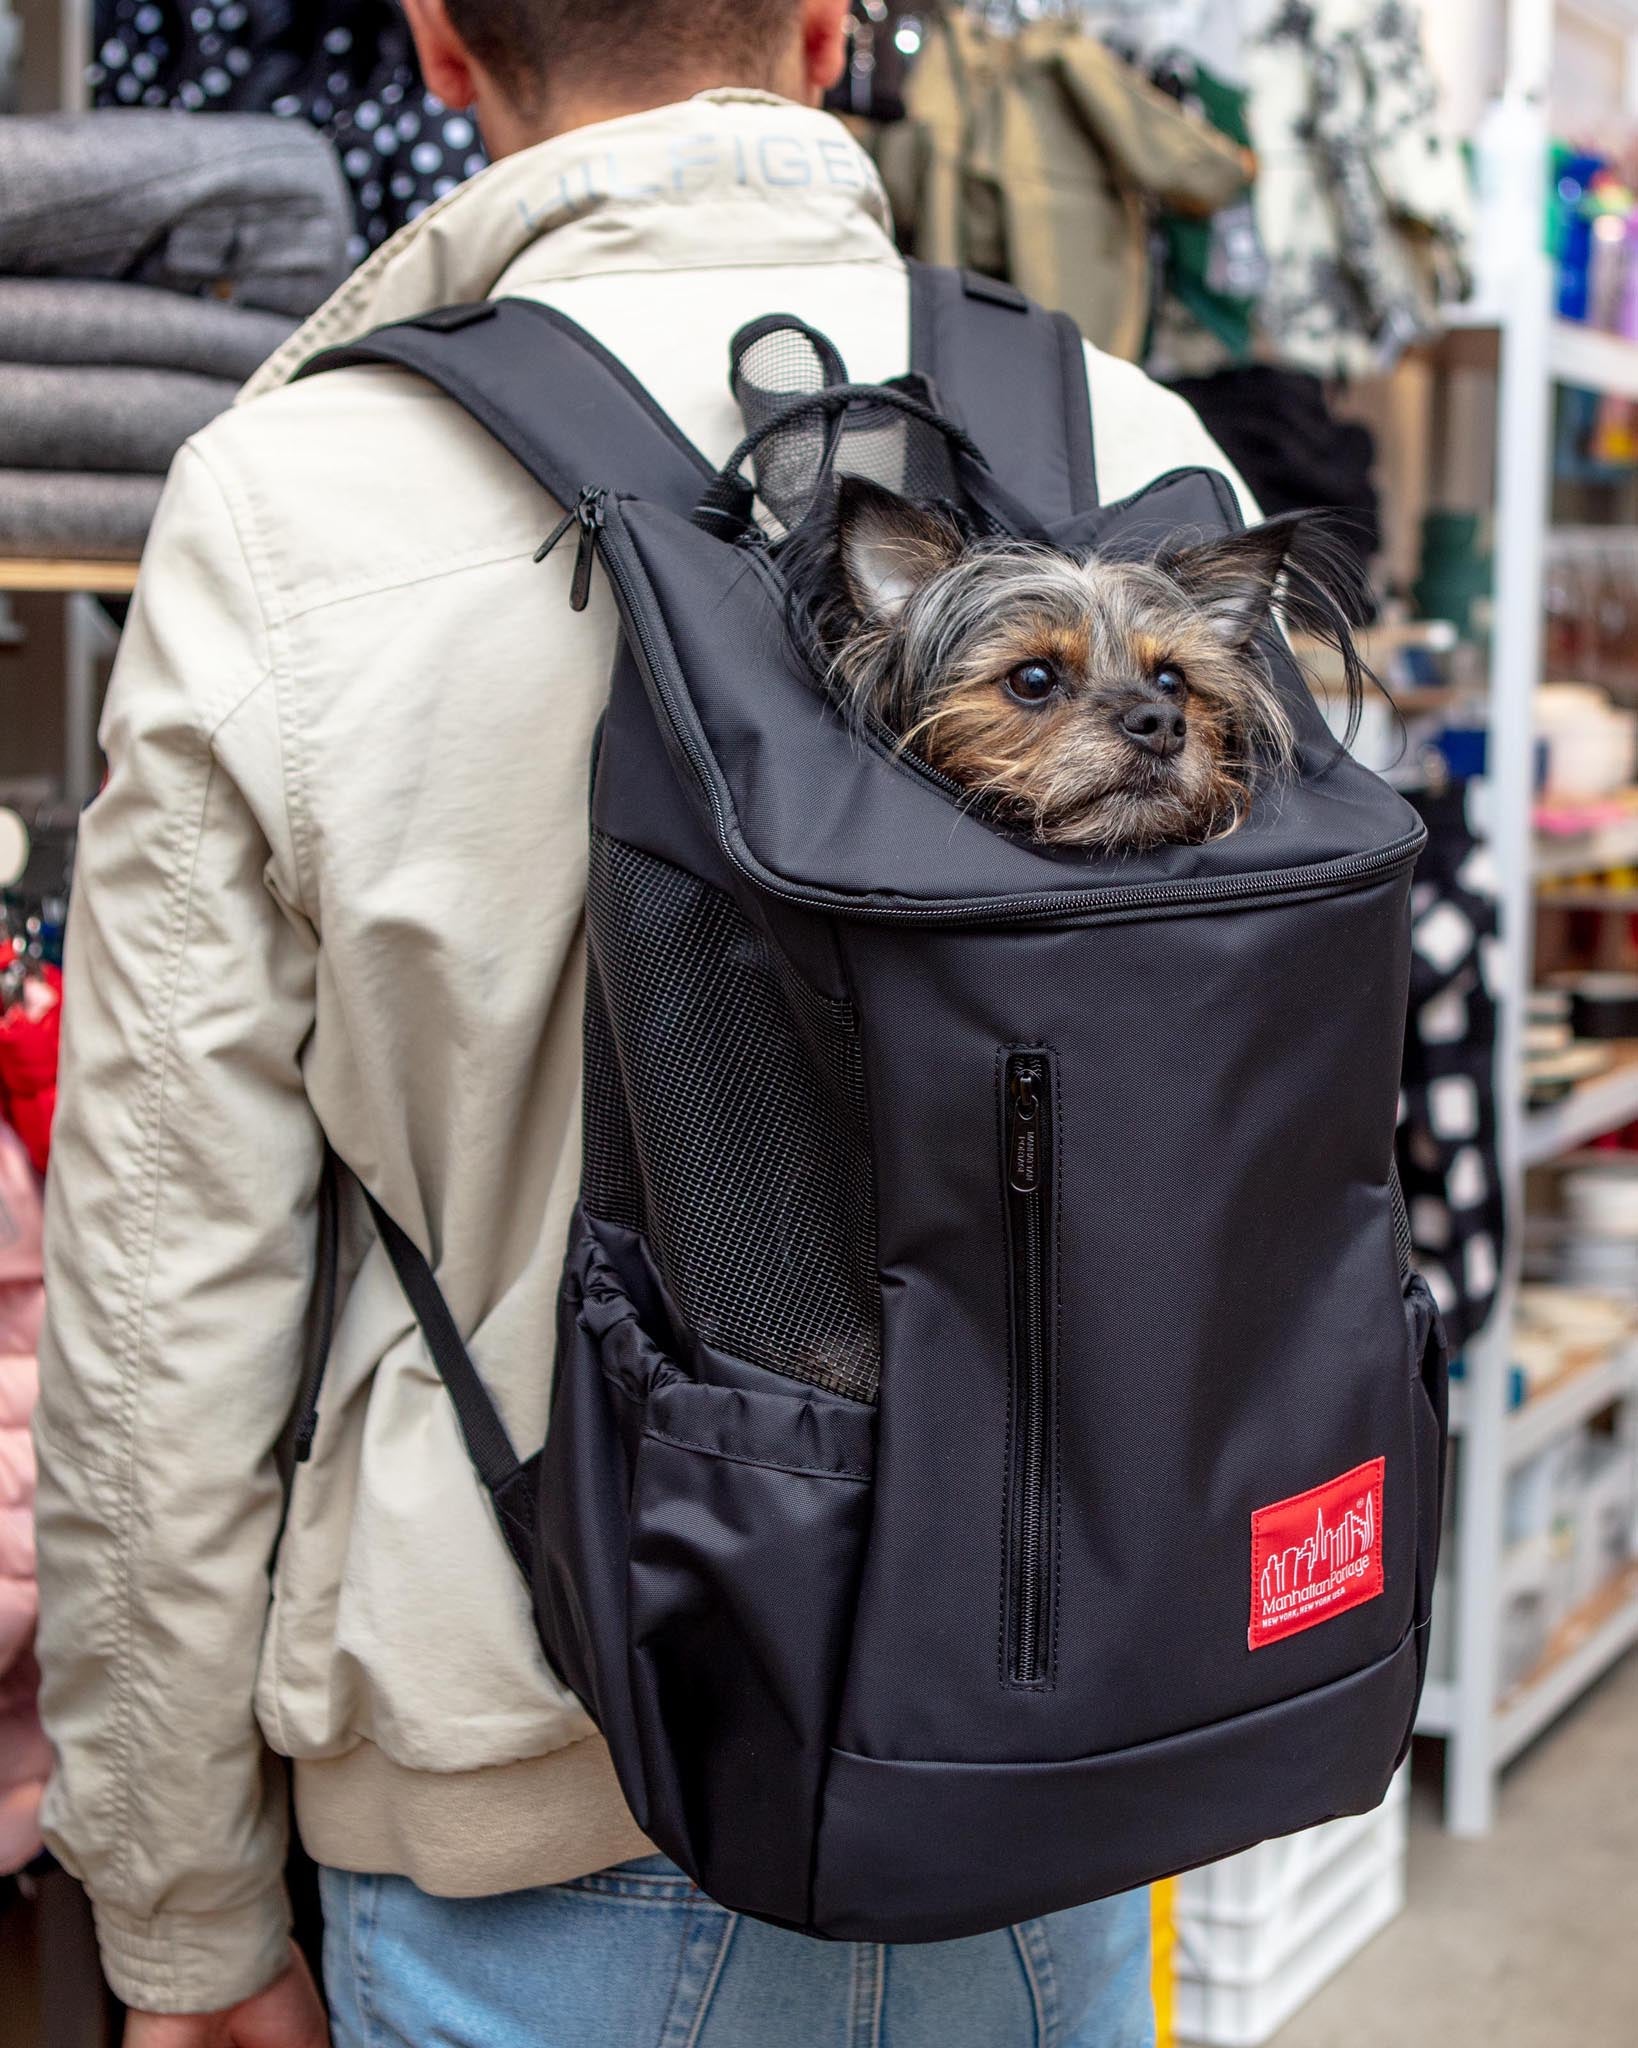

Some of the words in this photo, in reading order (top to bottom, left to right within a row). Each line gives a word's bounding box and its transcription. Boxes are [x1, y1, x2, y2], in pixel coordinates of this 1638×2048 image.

[1262, 1617, 1279, 1628] NEW
[1299, 1602, 1314, 1615] NEW
[1313, 1595, 1332, 1607] YORK
[1332, 1587, 1346, 1600] USA
